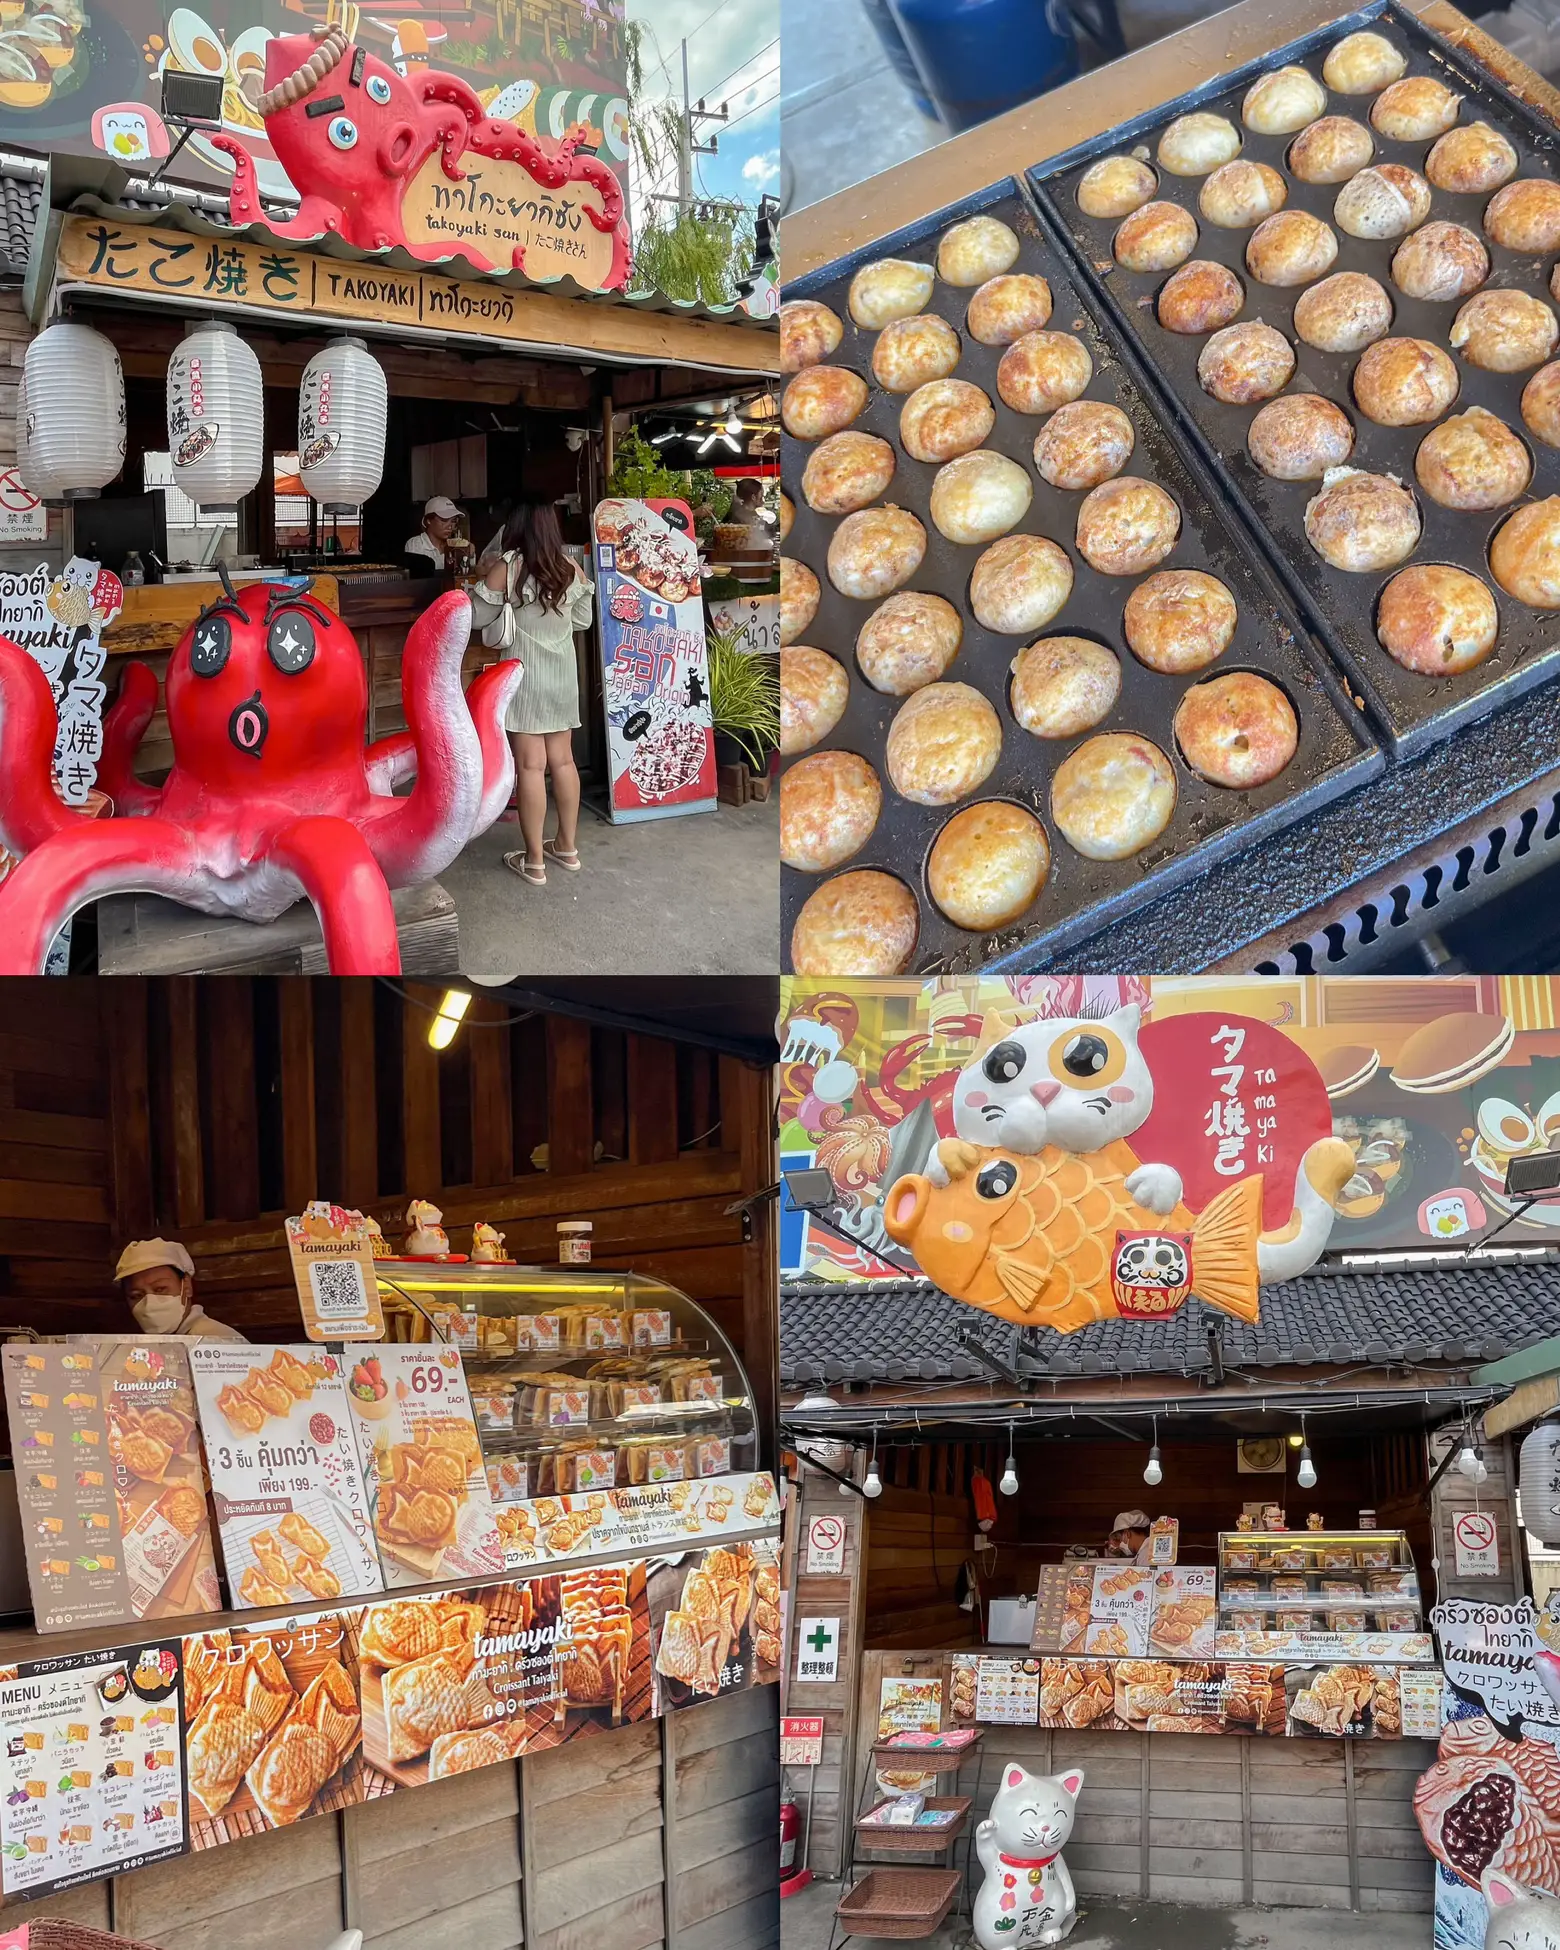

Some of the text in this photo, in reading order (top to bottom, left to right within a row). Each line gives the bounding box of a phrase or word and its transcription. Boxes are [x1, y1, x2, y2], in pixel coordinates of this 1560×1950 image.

[431, 172, 582, 232] ทาโกะยากิซัง
[425, 214, 520, 241] takoyaki san
[535, 233, 588, 260] たこ焼きさん
[86, 225, 301, 302] たこ焼き
[328, 272, 417, 307] TAKOYAKI
[428, 282, 514, 325] ทาโกะยากิ
[7, 513, 34, 524] 禁煙
[11, 526, 43, 535] Smoking
[0, 566, 45, 597] องต์
[621, 622, 703, 664] TAKOYAKI
[611, 671, 691, 706] Japan Origin
[67, 645, 102, 797] タマ焼き
[1204, 1025, 1251, 1176] タマ焼き
[1254, 1094, 1277, 1110] ma
[1257, 1115, 1278, 1138] ya
[300, 1240, 362, 1255] tamayaki
[401, 1351, 435, 1363] ราคาชิ้นละ
[113, 1379, 179, 1393] tamayaki
[411, 1366, 458, 1393] 69.-
[219, 1440, 319, 1475] 3 ชิ้น คุ้มกว่า
[258, 1477, 318, 1494] เพียง 199.-
[266, 1501, 271, 1510] 8
[273, 1502, 287, 1510] บาท
[336, 1426, 376, 1587] たい焼きクロワッサン
[616, 1488, 672, 1509] tamayaki
[503, 1550, 536, 1563] ロワッサン
[1466, 1551, 1489, 1562] 禁煙
[1095, 1599, 1101, 1608] 3
[1108, 1598, 1135, 1610] คุ้มกว่า
[1436, 1599, 1532, 1625] ครัวซองต์
[473, 1615, 574, 1659] tamayaki
[1300, 1633, 1343, 1643] tamayaki
[1479, 1624, 1534, 1648] ไทยากิ
[33, 1651, 116, 1673] クロワッサン たい焼き
[201, 1627, 345, 1675] クロワッサン
[801, 1661, 834, 1676] 整理整頓
[48, 1680, 94, 1695] メニュー
[493, 1669, 559, 1694] Croissant Taiyaki
[1174, 1677, 1233, 1693] tamayaki
[2, 1684, 41, 1705] MENU
[1489, 1694, 1560, 1720] たい焼き
[790, 1721, 819, 1732] 消火器
